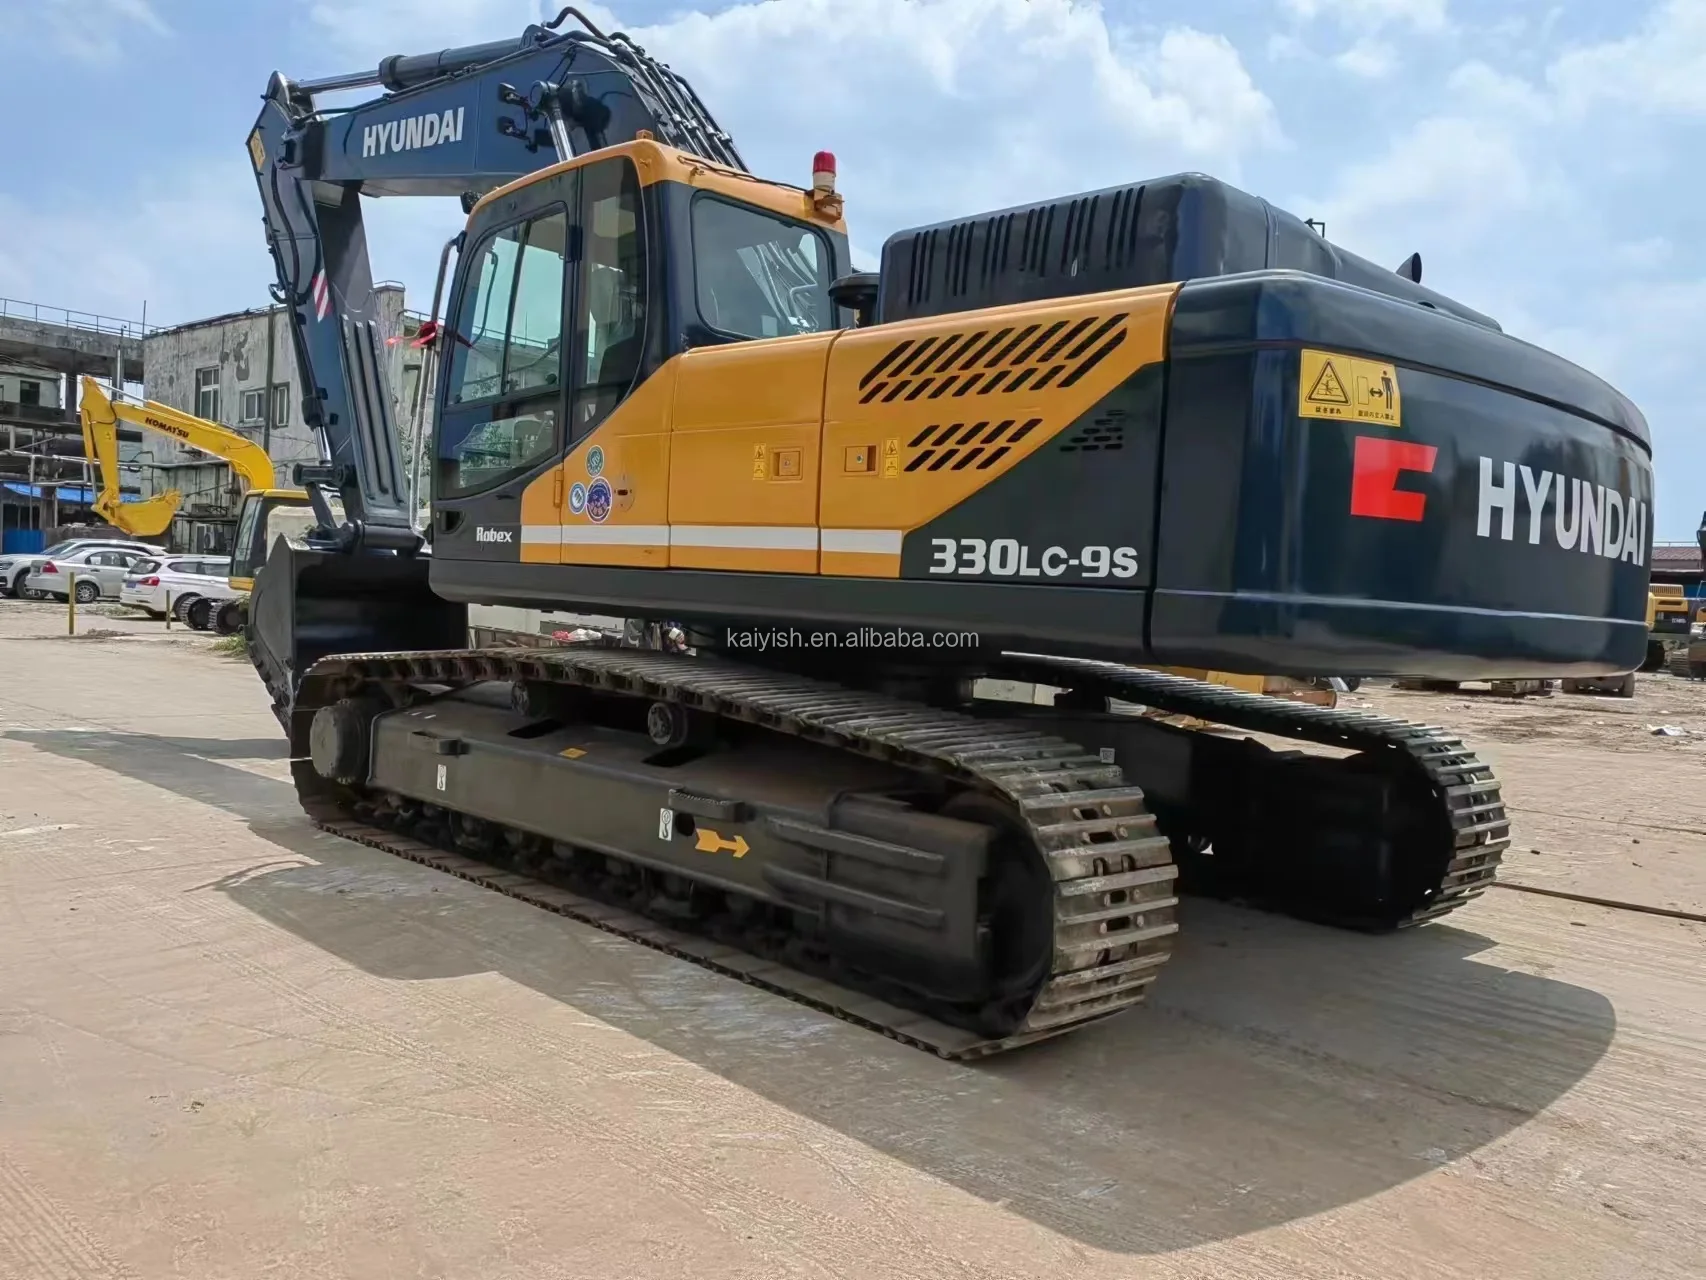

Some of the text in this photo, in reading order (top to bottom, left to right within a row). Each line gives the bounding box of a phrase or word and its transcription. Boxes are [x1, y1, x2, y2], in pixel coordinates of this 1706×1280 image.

[362, 107, 464, 158] HYUNDAI
[145, 417, 189, 438] KOMATSU
[1476, 456, 1647, 567] HYUNDAI
[476, 526, 513, 543] Robex
[929, 538, 1139, 578] 330LC-9S
